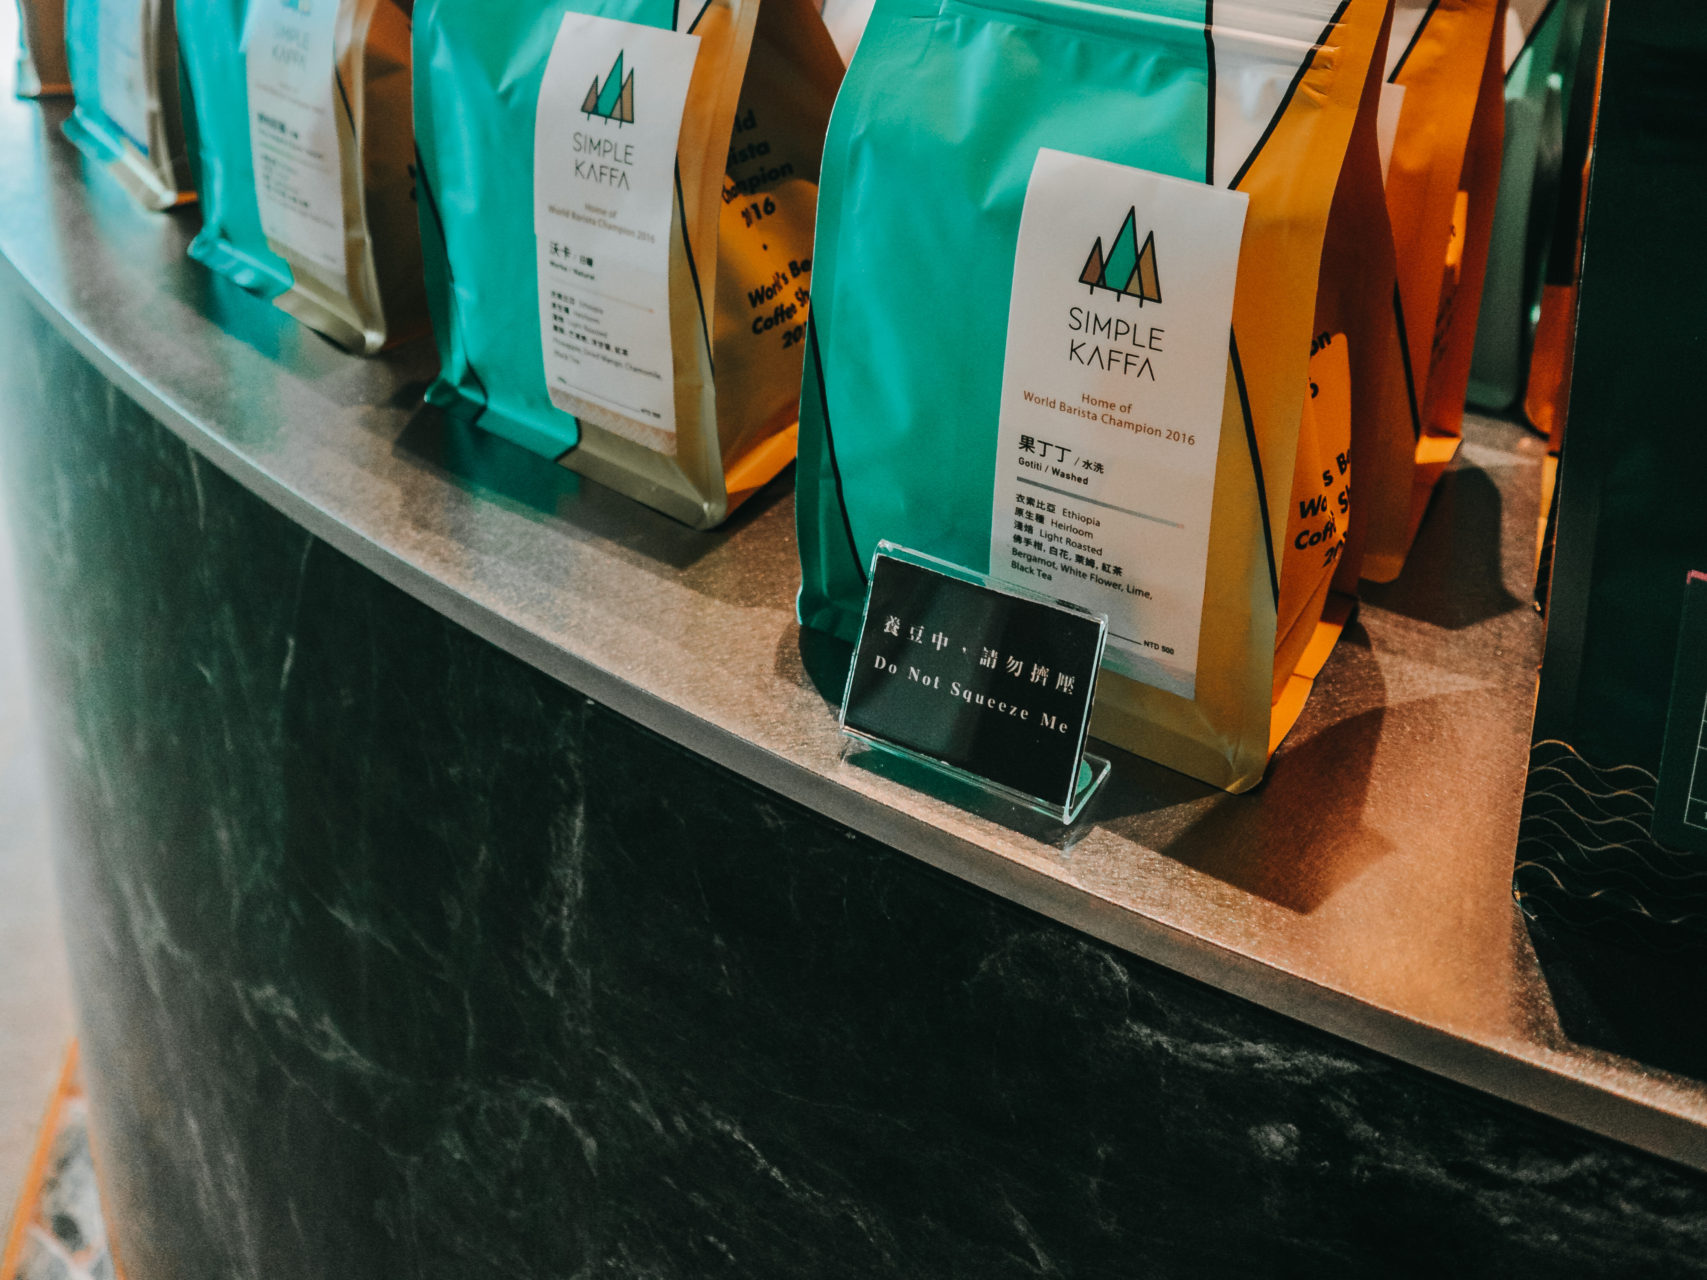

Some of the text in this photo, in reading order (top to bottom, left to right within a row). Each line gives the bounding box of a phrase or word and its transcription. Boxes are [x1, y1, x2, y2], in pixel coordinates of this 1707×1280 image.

[572, 131, 635, 166] SIMPLE
[574, 158, 630, 191] KAFFA
[1068, 306, 1165, 352] SIMPLE
[1069, 338, 1156, 382] KAFFA
[1023, 390, 1196, 446] World Barista Champion 2016
[1081, 393, 1133, 415] Home of
[1018, 434, 1072, 463] 果丁丁
[1081, 459, 1105, 474] 水洗
[1018, 456, 1043, 472] Gotiti
[1051, 466, 1089, 486] Washed
[1051, 518, 1094, 540] Heirloom
[1062, 508, 1101, 528] Ethiopia
[1039, 528, 1063, 544] Light
[1065, 538, 1103, 557] Roasted
[1011, 560, 1053, 581] Black Tea
[1011, 547, 1153, 600] Bergamot, White Flower, Lime,
[1143, 640, 1160, 651] NTD
[874, 655, 1069, 734] Do Not Squeeze Me
